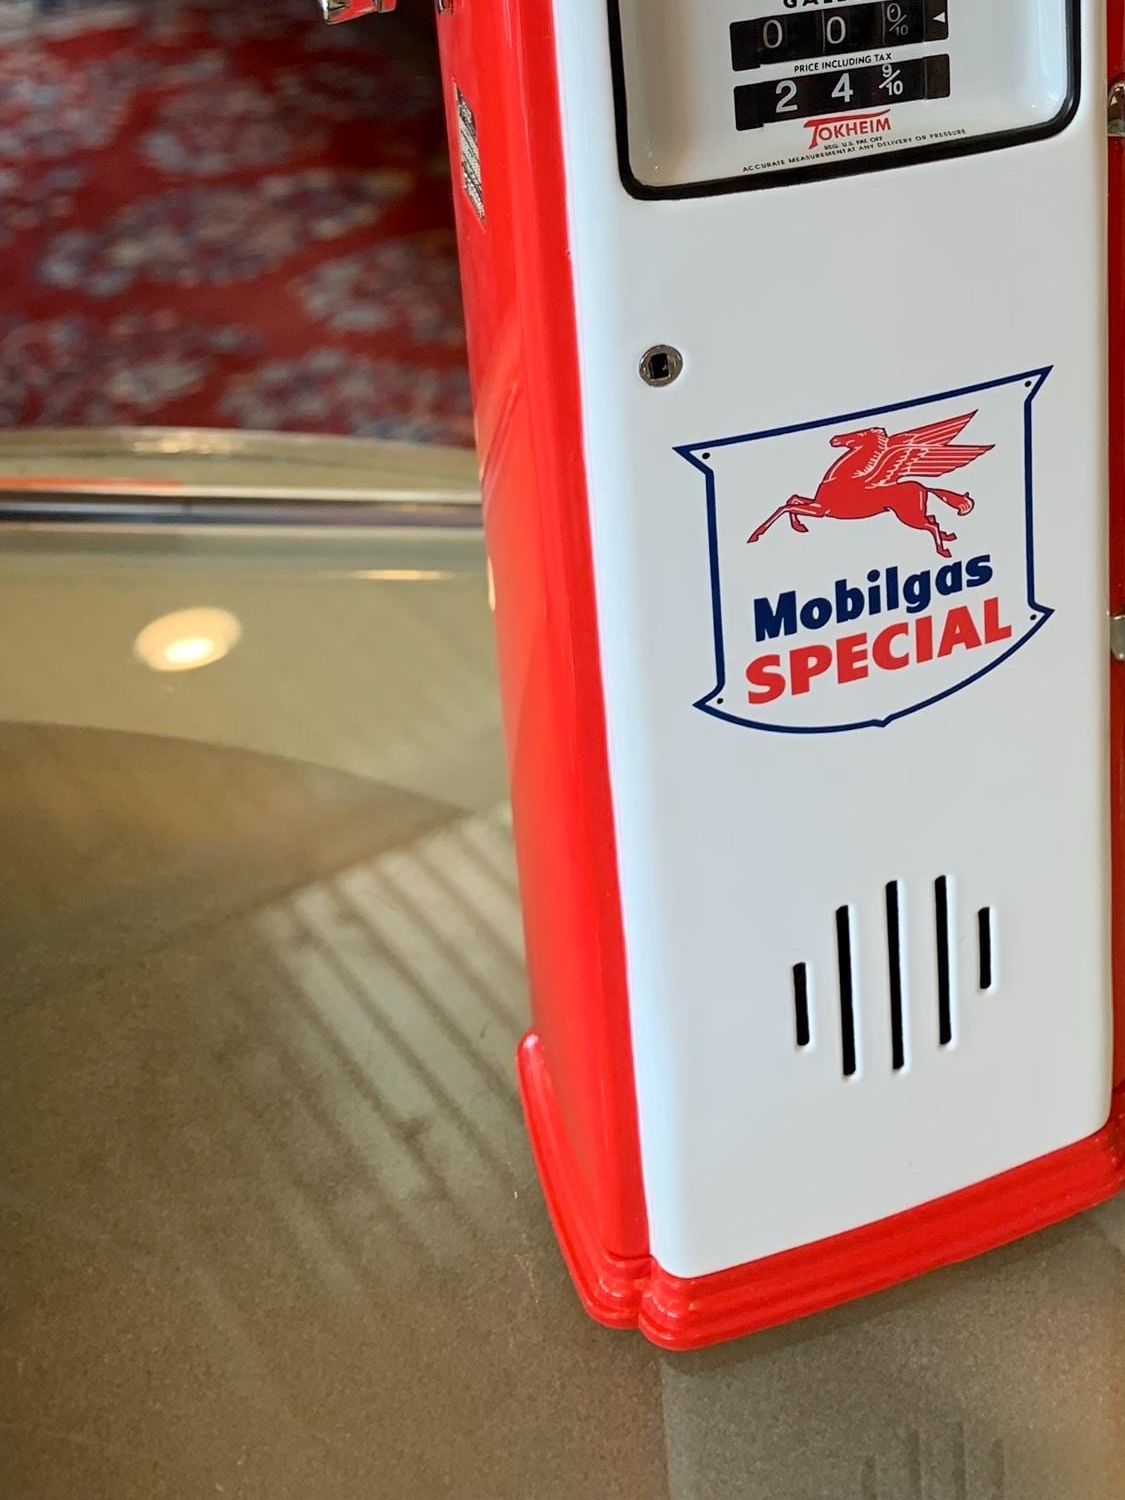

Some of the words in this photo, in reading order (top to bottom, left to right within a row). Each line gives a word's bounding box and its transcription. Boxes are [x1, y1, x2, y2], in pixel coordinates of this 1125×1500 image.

[793, 62, 819, 73] PRICE
[821, 55, 872, 70] INCLUDING
[874, 52, 892, 61] TAX
[803, 108, 892, 150] TOKHEIM
[742, 159, 786, 173] ACCURATE
[859, 143, 874, 151] ANY
[877, 137, 912, 148] DELIVERY
[753, 554, 993, 642] Mobilgas
[745, 596, 1013, 705] SPECIAL
